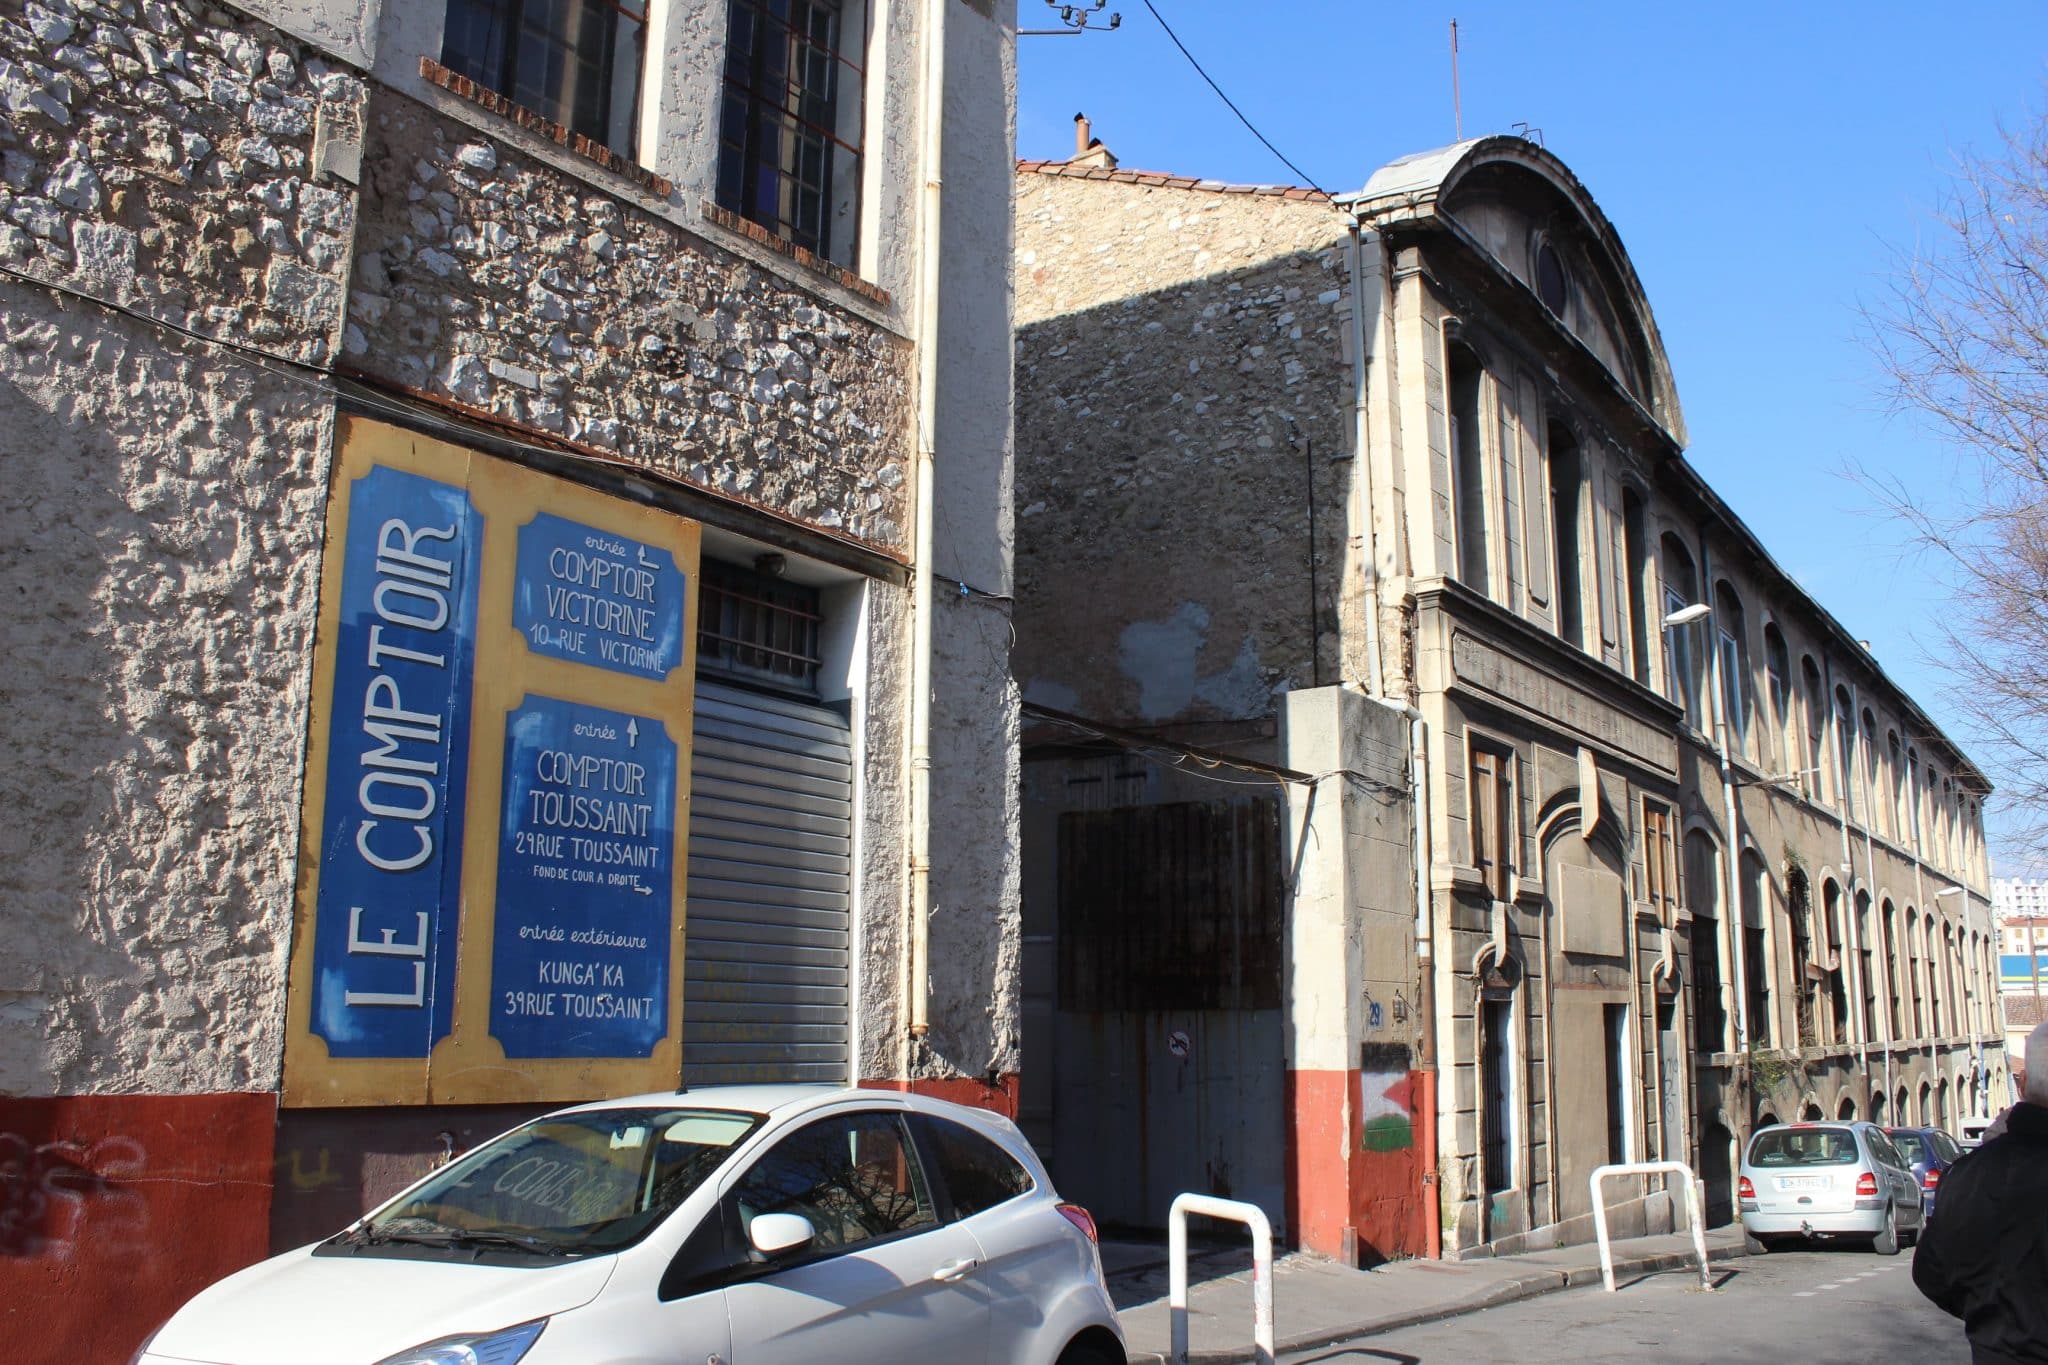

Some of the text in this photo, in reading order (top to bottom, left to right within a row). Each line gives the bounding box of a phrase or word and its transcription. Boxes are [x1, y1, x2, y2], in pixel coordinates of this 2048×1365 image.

[585, 536, 627, 557] entrée
[550, 547, 655, 603] COMPTOIR
[545, 584, 656, 642] VICTORINE
[530, 623, 666, 673] 10 RUE VICTORINE
[574, 723, 617, 740] entrée
[345, 518, 457, 1008] LE COMPTOIR
[537, 750, 646, 796] COMPTOIR
[529, 789, 652, 837] TOUSSAINT
[570, 837, 659, 868] TOUSSAINT
[533, 864, 556, 879] FOND
[558, 868, 569, 880] DE
[572, 870, 594, 883] COUR
[608, 873, 641, 887] DROITE
[519, 924, 648, 949] entrée extérieure
[562, 993, 654, 1020] TOUSSAINT
